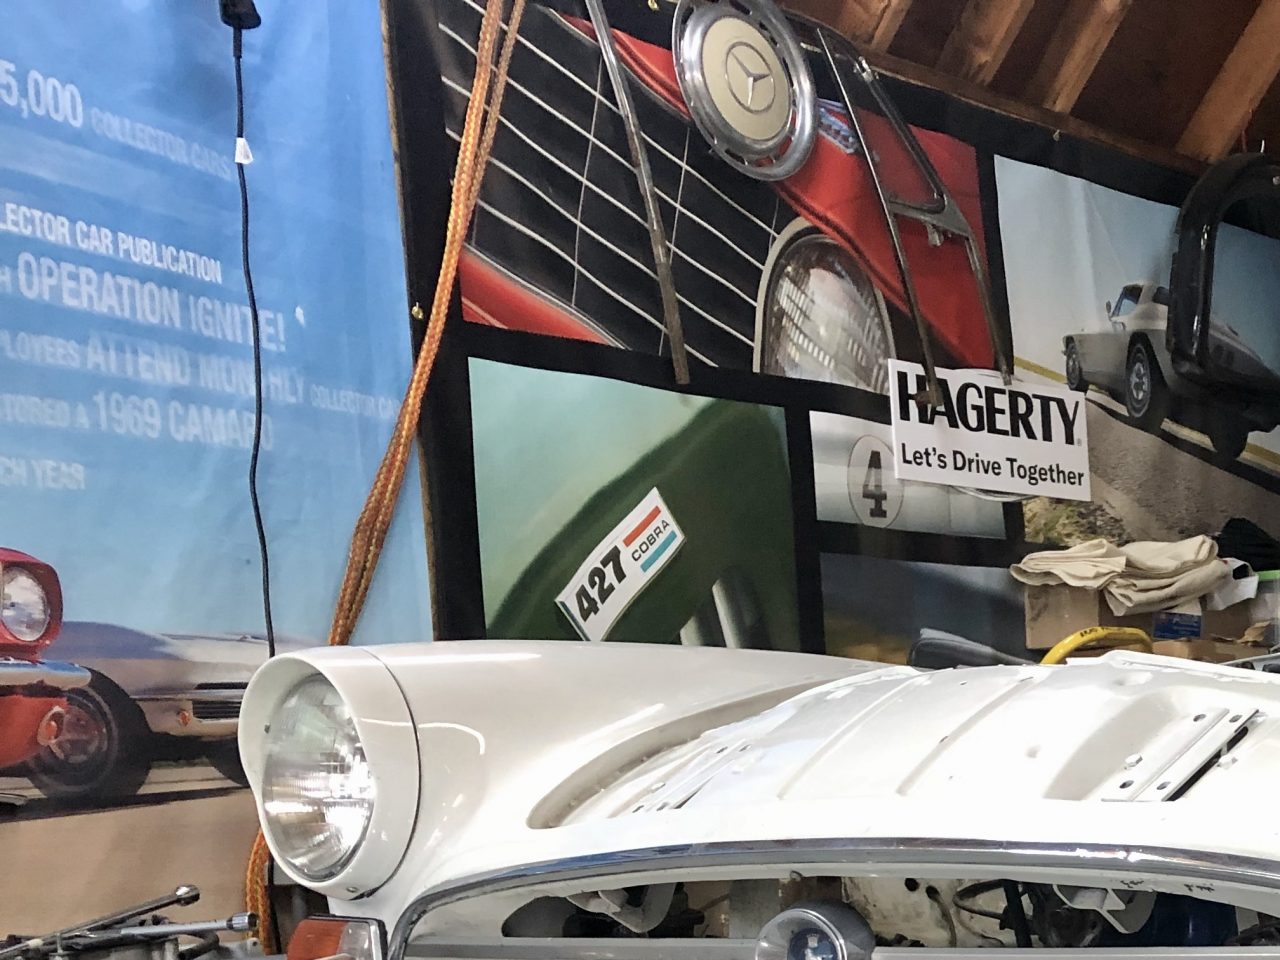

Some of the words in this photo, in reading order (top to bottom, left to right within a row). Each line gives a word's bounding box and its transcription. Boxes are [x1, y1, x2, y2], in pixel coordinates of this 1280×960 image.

[76, 220, 113, 255] CAR
[117, 232, 222, 284] PUBLICATION
[18, 252, 181, 328] OPERATION
[189, 294, 286, 352] IGNITE!
[93, 390, 162, 440] 1969
[897, 371, 1080, 445] HAGERTY
[862, 450, 888, 518] 4
[902, 442, 948, 469] Let's
[953, 450, 1001, 476] Drive
[1006, 457, 1085, 486] Together
[631, 519, 670, 562] COBRA
[575, 545, 627, 622] 427
